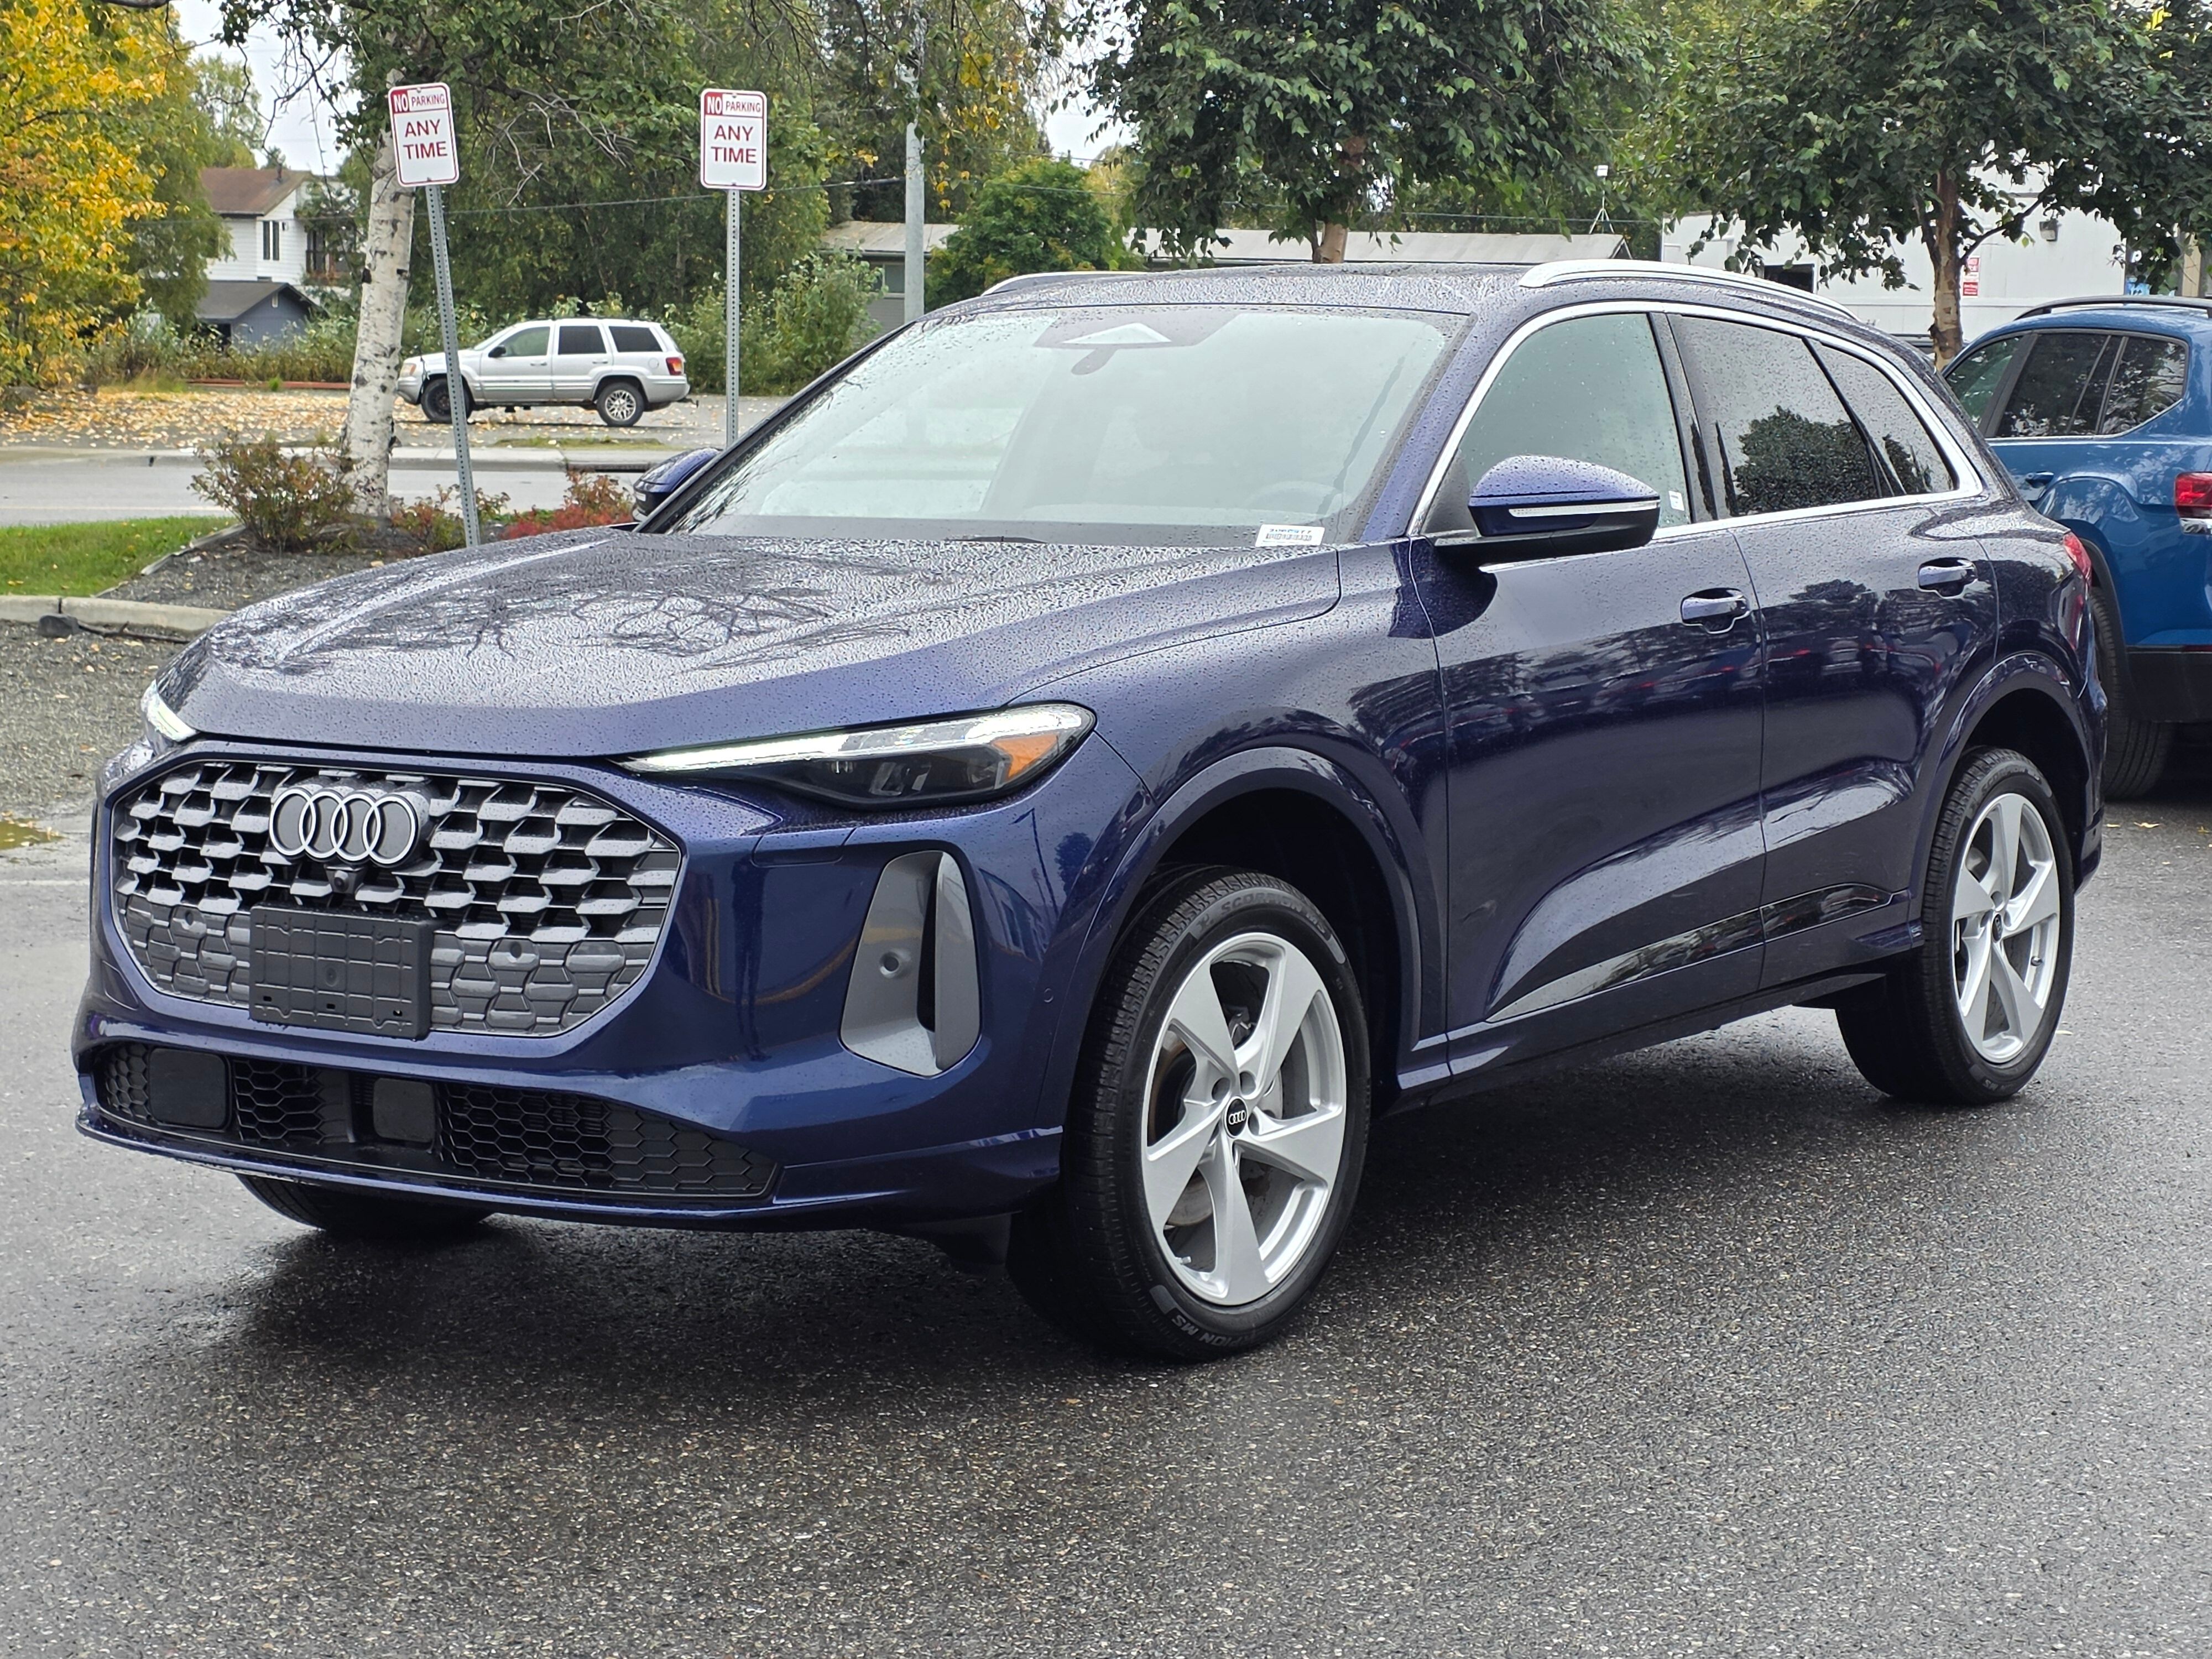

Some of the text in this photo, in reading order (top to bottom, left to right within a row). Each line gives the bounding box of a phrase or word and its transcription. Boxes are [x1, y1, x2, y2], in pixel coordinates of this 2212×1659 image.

[394, 93, 445, 112] NO PARKING
[707, 96, 761, 114] NO PARKING
[405, 118, 441, 138] ANY
[714, 124, 754, 142] ANY
[403, 141, 448, 160] TIME
[711, 146, 757, 164] TIME
[1171, 1314, 1199, 1336] MS
